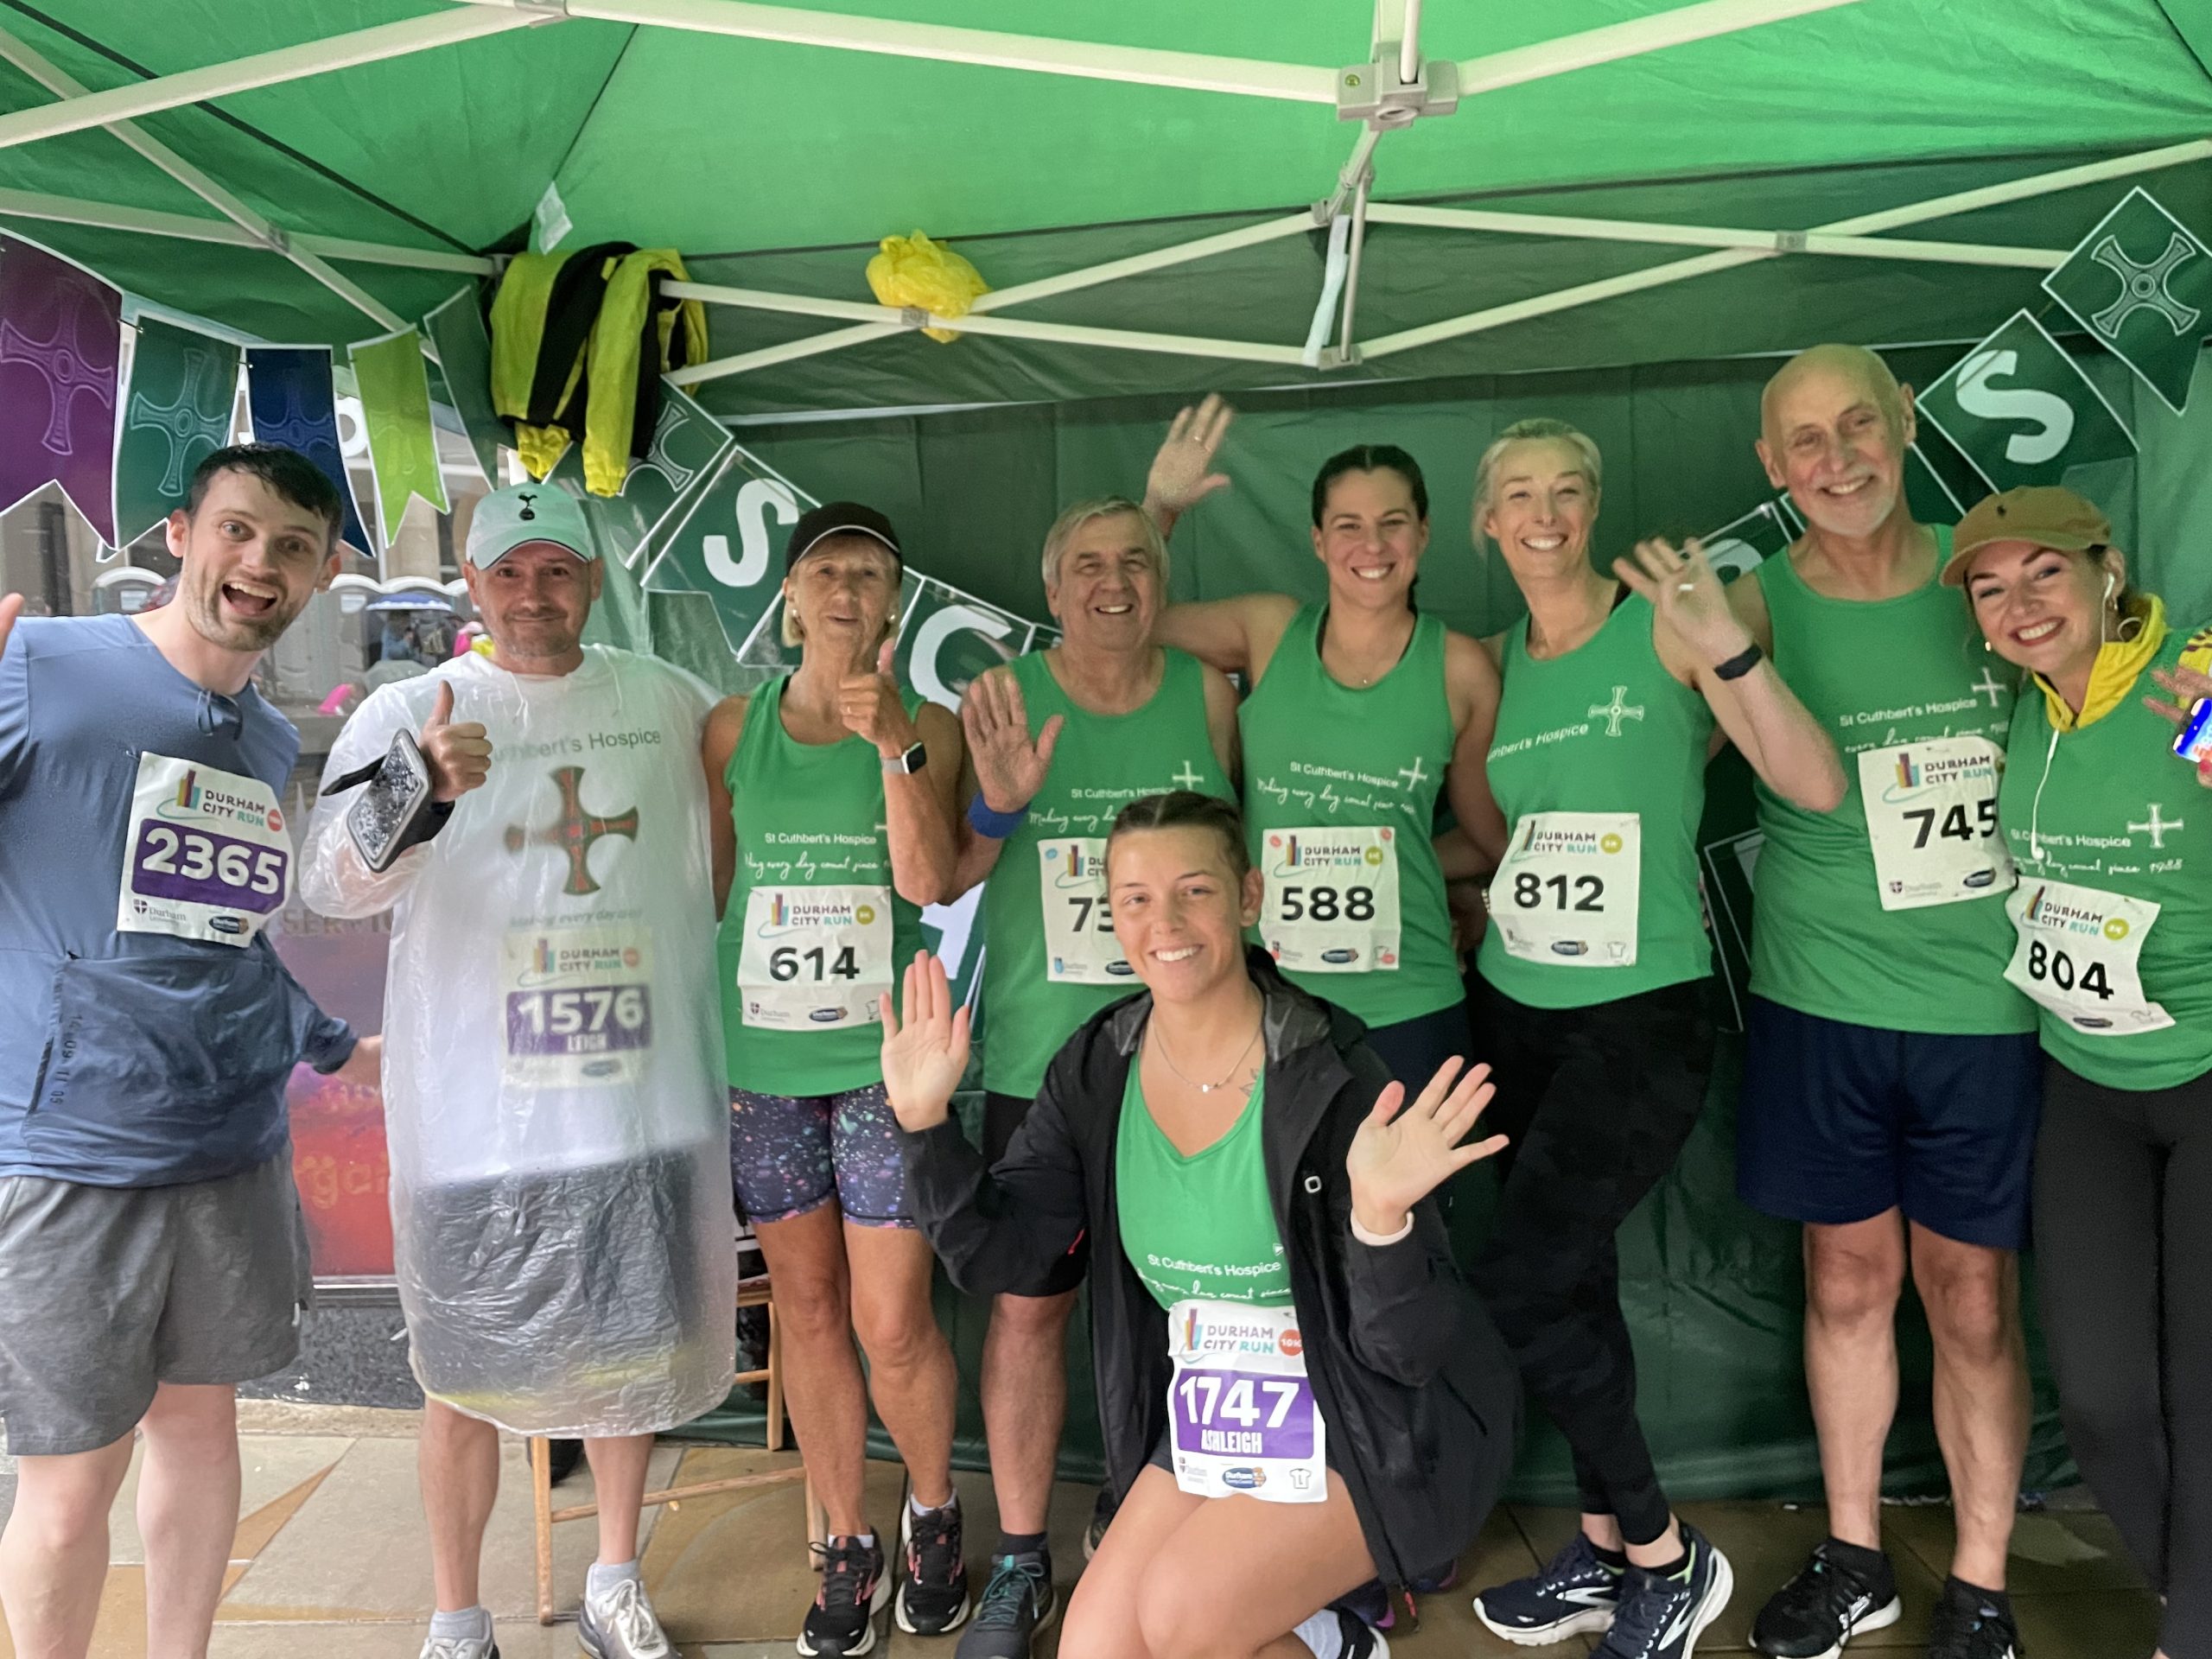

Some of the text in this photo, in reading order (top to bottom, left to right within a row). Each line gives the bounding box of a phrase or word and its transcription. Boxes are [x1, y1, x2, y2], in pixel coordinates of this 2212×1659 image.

[1840, 697, 1978, 727] St Cuthbert's Hospice
[493, 728, 662, 762] uthbert's Hospice
[1535, 723, 1589, 746] Hospice
[1290, 761, 1399, 789] St Cuthbert's Hospice
[1925, 755, 1991, 773] DURHAM
[1926, 767, 1993, 785] CITY RUN
[205, 790, 265, 815] DURHAM
[1071, 789, 1083, 798] St
[1084, 789, 1135, 798] Cuthbert's
[202, 803, 234, 818] CITY
[237, 810, 265, 827] RUN
[1103, 804, 1117, 822] da
[1903, 798, 1998, 849] 745
[764, 833, 877, 847] St Cuthbert's Hospice
[1536, 830, 1597, 842] DURHAM
[2075, 835, 2132, 849] Hospice
[1304, 846, 1362, 856] DURHAM
[1534, 842, 1598, 855] CITY RUN
[142, 827, 283, 895] 2365
[1304, 857, 1362, 867] CITY RUN
[1514, 872, 1605, 912] 812
[792, 905, 851, 914] DURHAM
[1068, 897, 1115, 932] 73
[1281, 886, 1376, 922] 588
[2044, 902, 2104, 924] DURHAM
[791, 916, 853, 925] CITY RUN
[2041, 915, 2101, 937] CITY RUN
[560, 948, 620, 960] DURHAM
[769, 945, 861, 982] 614
[559, 960, 591, 972] CITY
[2028, 939, 2115, 1001] 804
[518, 988, 645, 1034] 1576
[1147, 1254, 1282, 1277] St Cuthbert's Hospice
[1207, 1325, 1274, 1339] DURHAM
[1204, 1339, 1274, 1354] CITY RUN
[1179, 1376, 1300, 1428] 1747
[1200, 1428, 1263, 1455] ASHLEIGH
